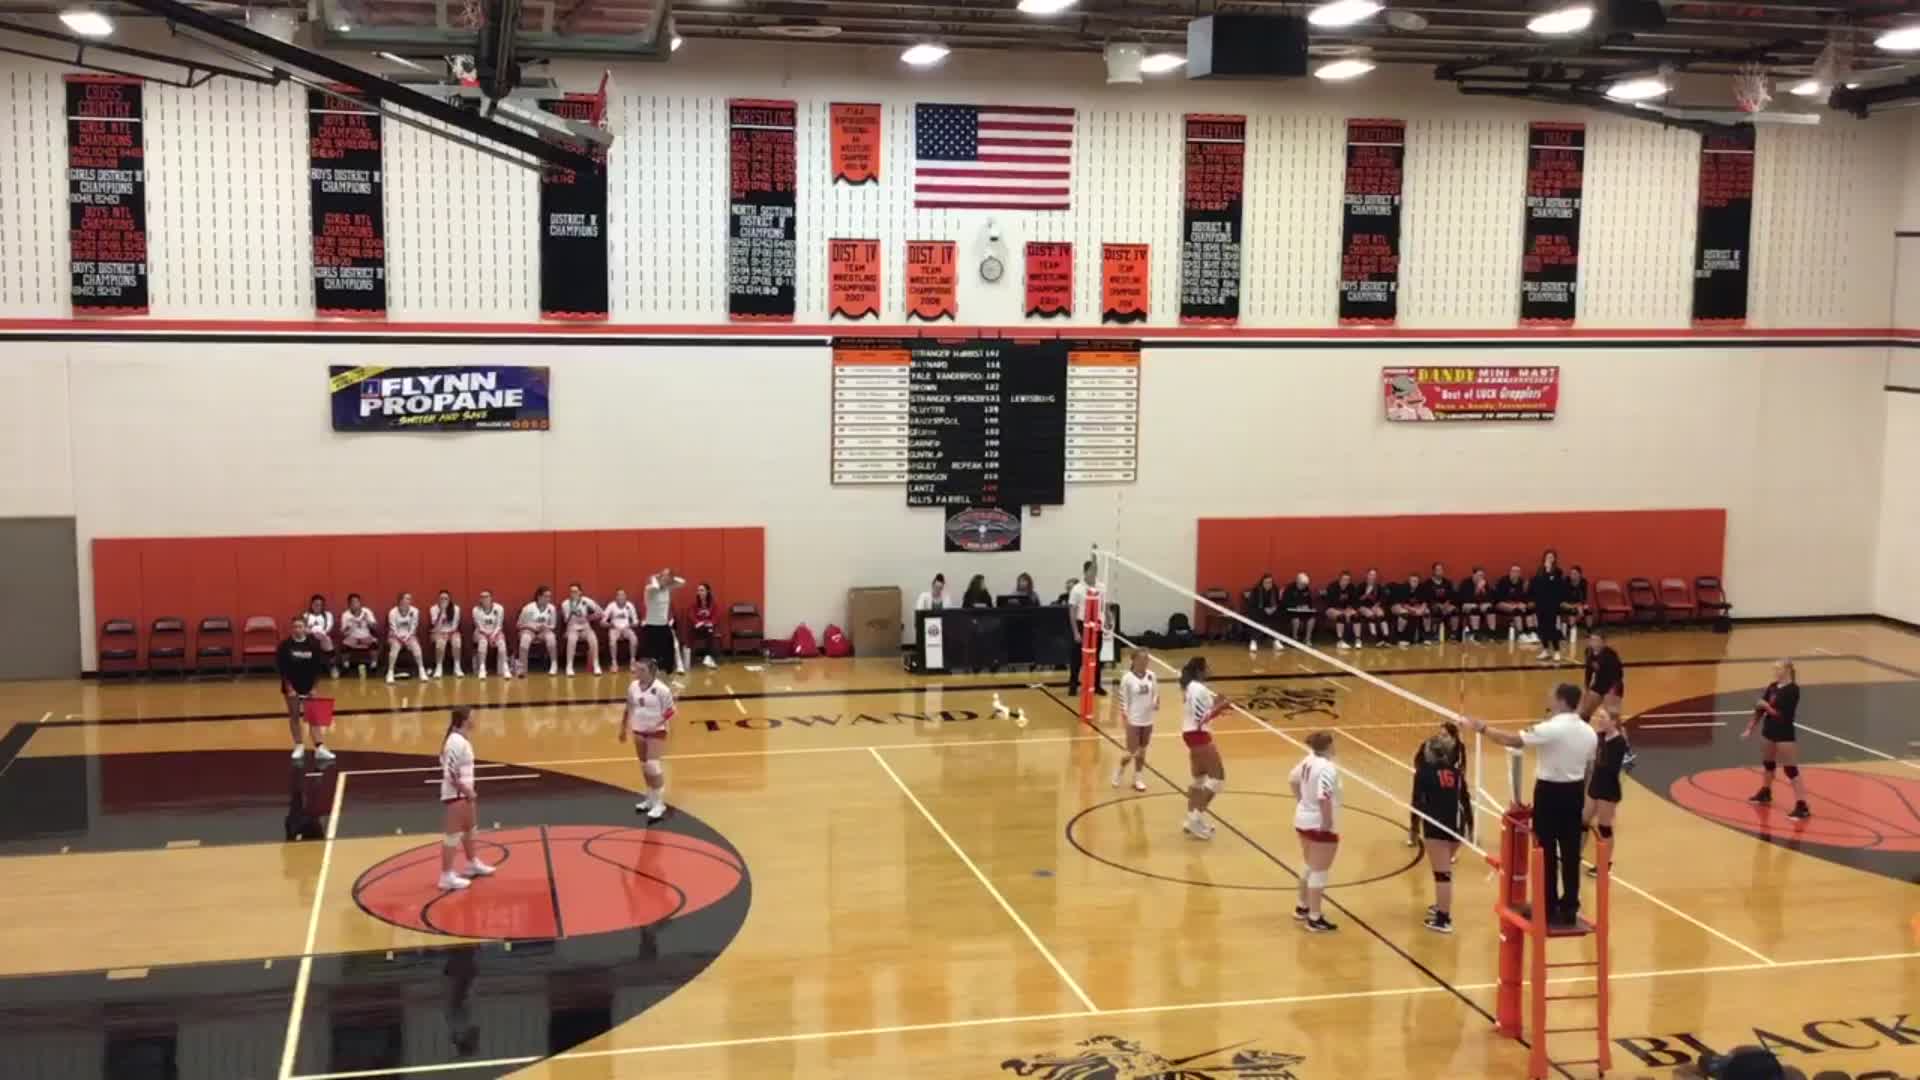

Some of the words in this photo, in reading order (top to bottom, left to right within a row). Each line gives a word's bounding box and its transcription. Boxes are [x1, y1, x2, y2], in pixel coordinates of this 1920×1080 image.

[732, 110, 793, 125] WRESTLING
[319, 127, 372, 139] CHAMPIONS
[79, 134, 132, 146] CHAMPIONS
[70, 169, 95, 181] GIRLS
[97, 170, 133, 182] DISTRICT
[311, 168, 332, 180] BOYS
[334, 169, 369, 181] DISTRICT
[80, 182, 133, 194] CHAMPIONS
[321, 181, 371, 194] CHAMPIONS
[1365, 195, 1392, 205] DISTRICT
[1545, 198, 1572, 208] DISTRICT
[731, 205, 756, 216] NORTH
[760, 206, 793, 217] SECTION
[1351, 204, 1392, 215] CHAMPIONS
[1532, 207, 1573, 218] CHAMPIONS
[81, 218, 134, 230] CHAMPIONS
[550, 214, 585, 225] DISTRICT
[740, 216, 773, 227] DISTRICT
[323, 225, 373, 237] CHAMPIONS
[550, 225, 599, 237] CHAMPIONS
[1192, 222, 1221, 232] DISTRICT
[740, 228, 784, 239] CHAMPIONS
[1190, 232, 1232, 242] CHAMPIONS
[865, 244, 877, 263] IV
[941, 246, 953, 264] IV
[1060, 246, 1071, 256] IV
[1134, 249, 1147, 260] IV
[1704, 249, 1731, 259] DISTRICT
[72, 262, 95, 274] BOYS
[97, 263, 136, 275] DISTRICT
[845, 264, 865, 272] TEAM
[1703, 260, 1740, 270] CHAMPIONS
[314, 267, 338, 278] GIRLS
[340, 267, 373, 279] DISTRICT
[833, 274, 876, 282] WRESTLING
[82, 274, 137, 287] CHAMPIONS
[324, 279, 374, 291] CHAMPIONS
[1360, 281, 1388, 292] DISTRICT
[1541, 282, 1568, 293] DISTRICT
[1347, 291, 1388, 302] CHAMPIONS
[1528, 293, 1568, 302] CHAMPIONS
[1417, 368, 1476, 383] DANDY
[1478, 369, 1510, 377] MINI
[1518, 369, 1555, 377] MART
[381, 371, 497, 397] FLYNN
[1464, 388, 1474, 399] of
[1476, 388, 1497, 399] LUCK
[360, 389, 524, 417] PROPANE
[462, 410, 488, 421] SAVE
[908, 483, 936, 493] LANTZ
